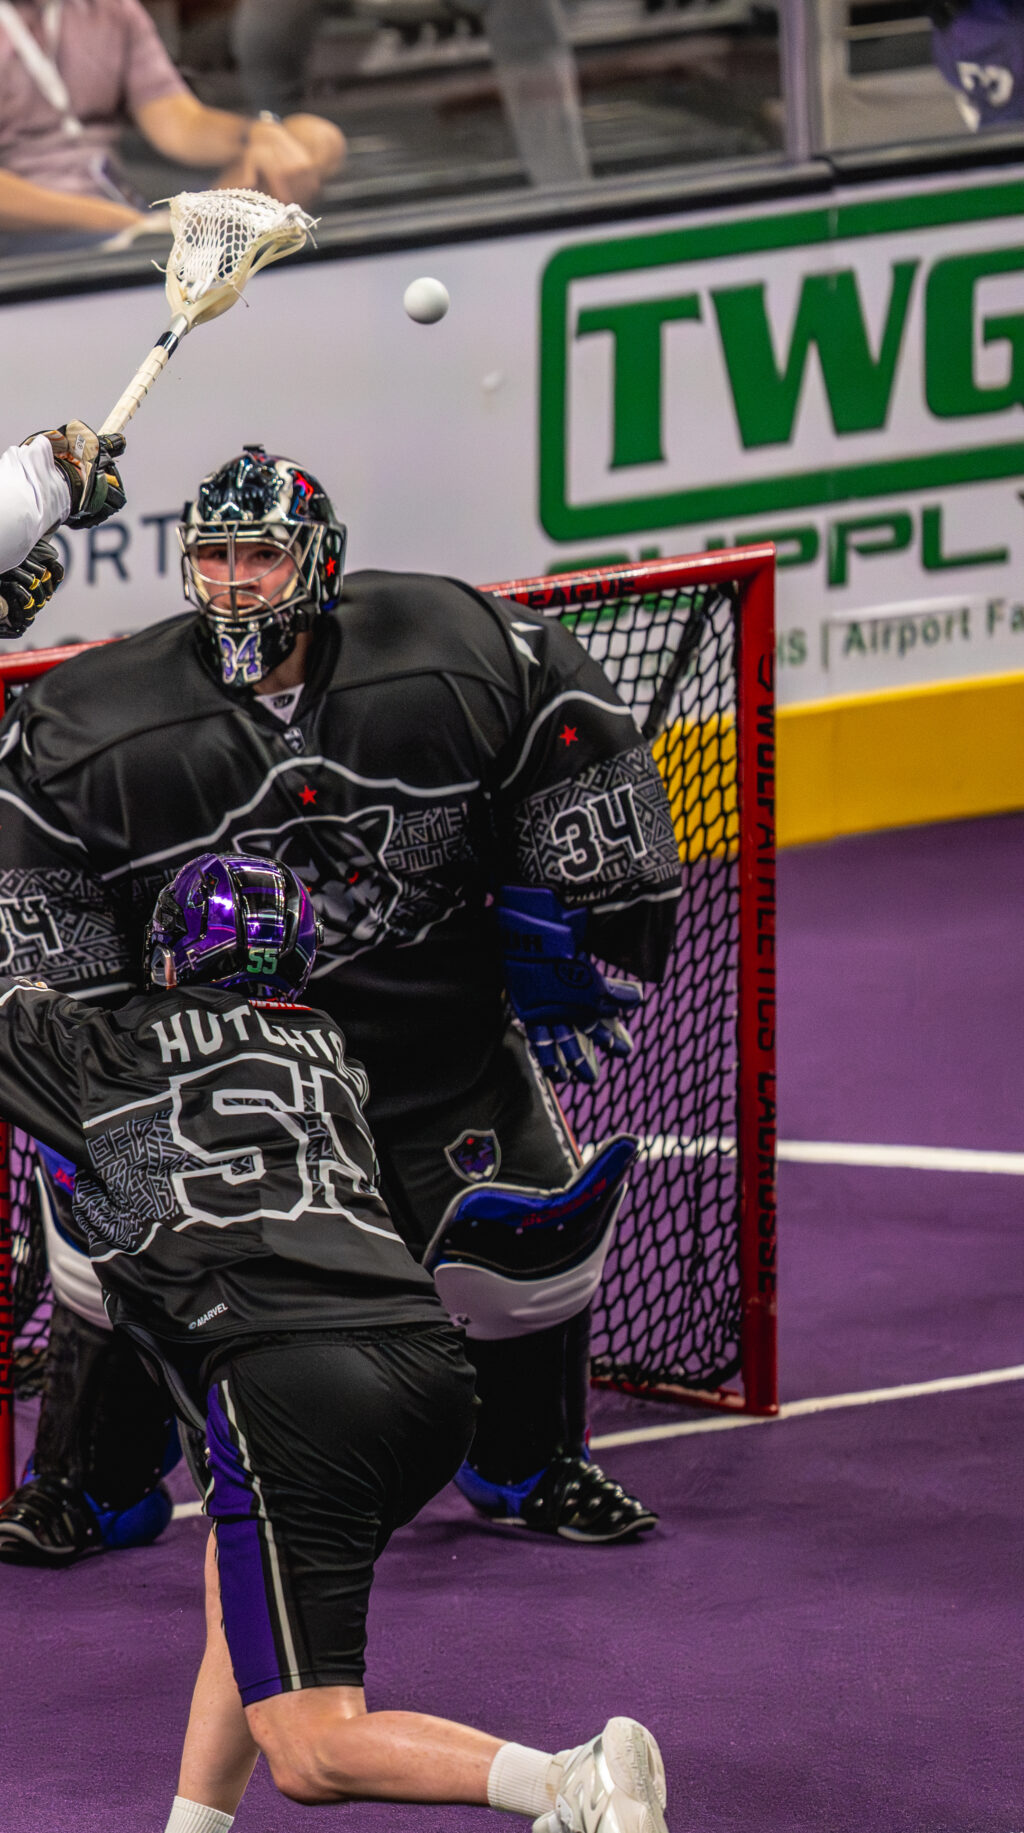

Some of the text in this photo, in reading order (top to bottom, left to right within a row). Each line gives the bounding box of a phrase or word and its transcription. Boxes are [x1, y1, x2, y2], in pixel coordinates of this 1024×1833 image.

[843, 607, 970, 660] Airport
[550, 783, 648, 883] 34
[246, 946, 277, 975] 55
